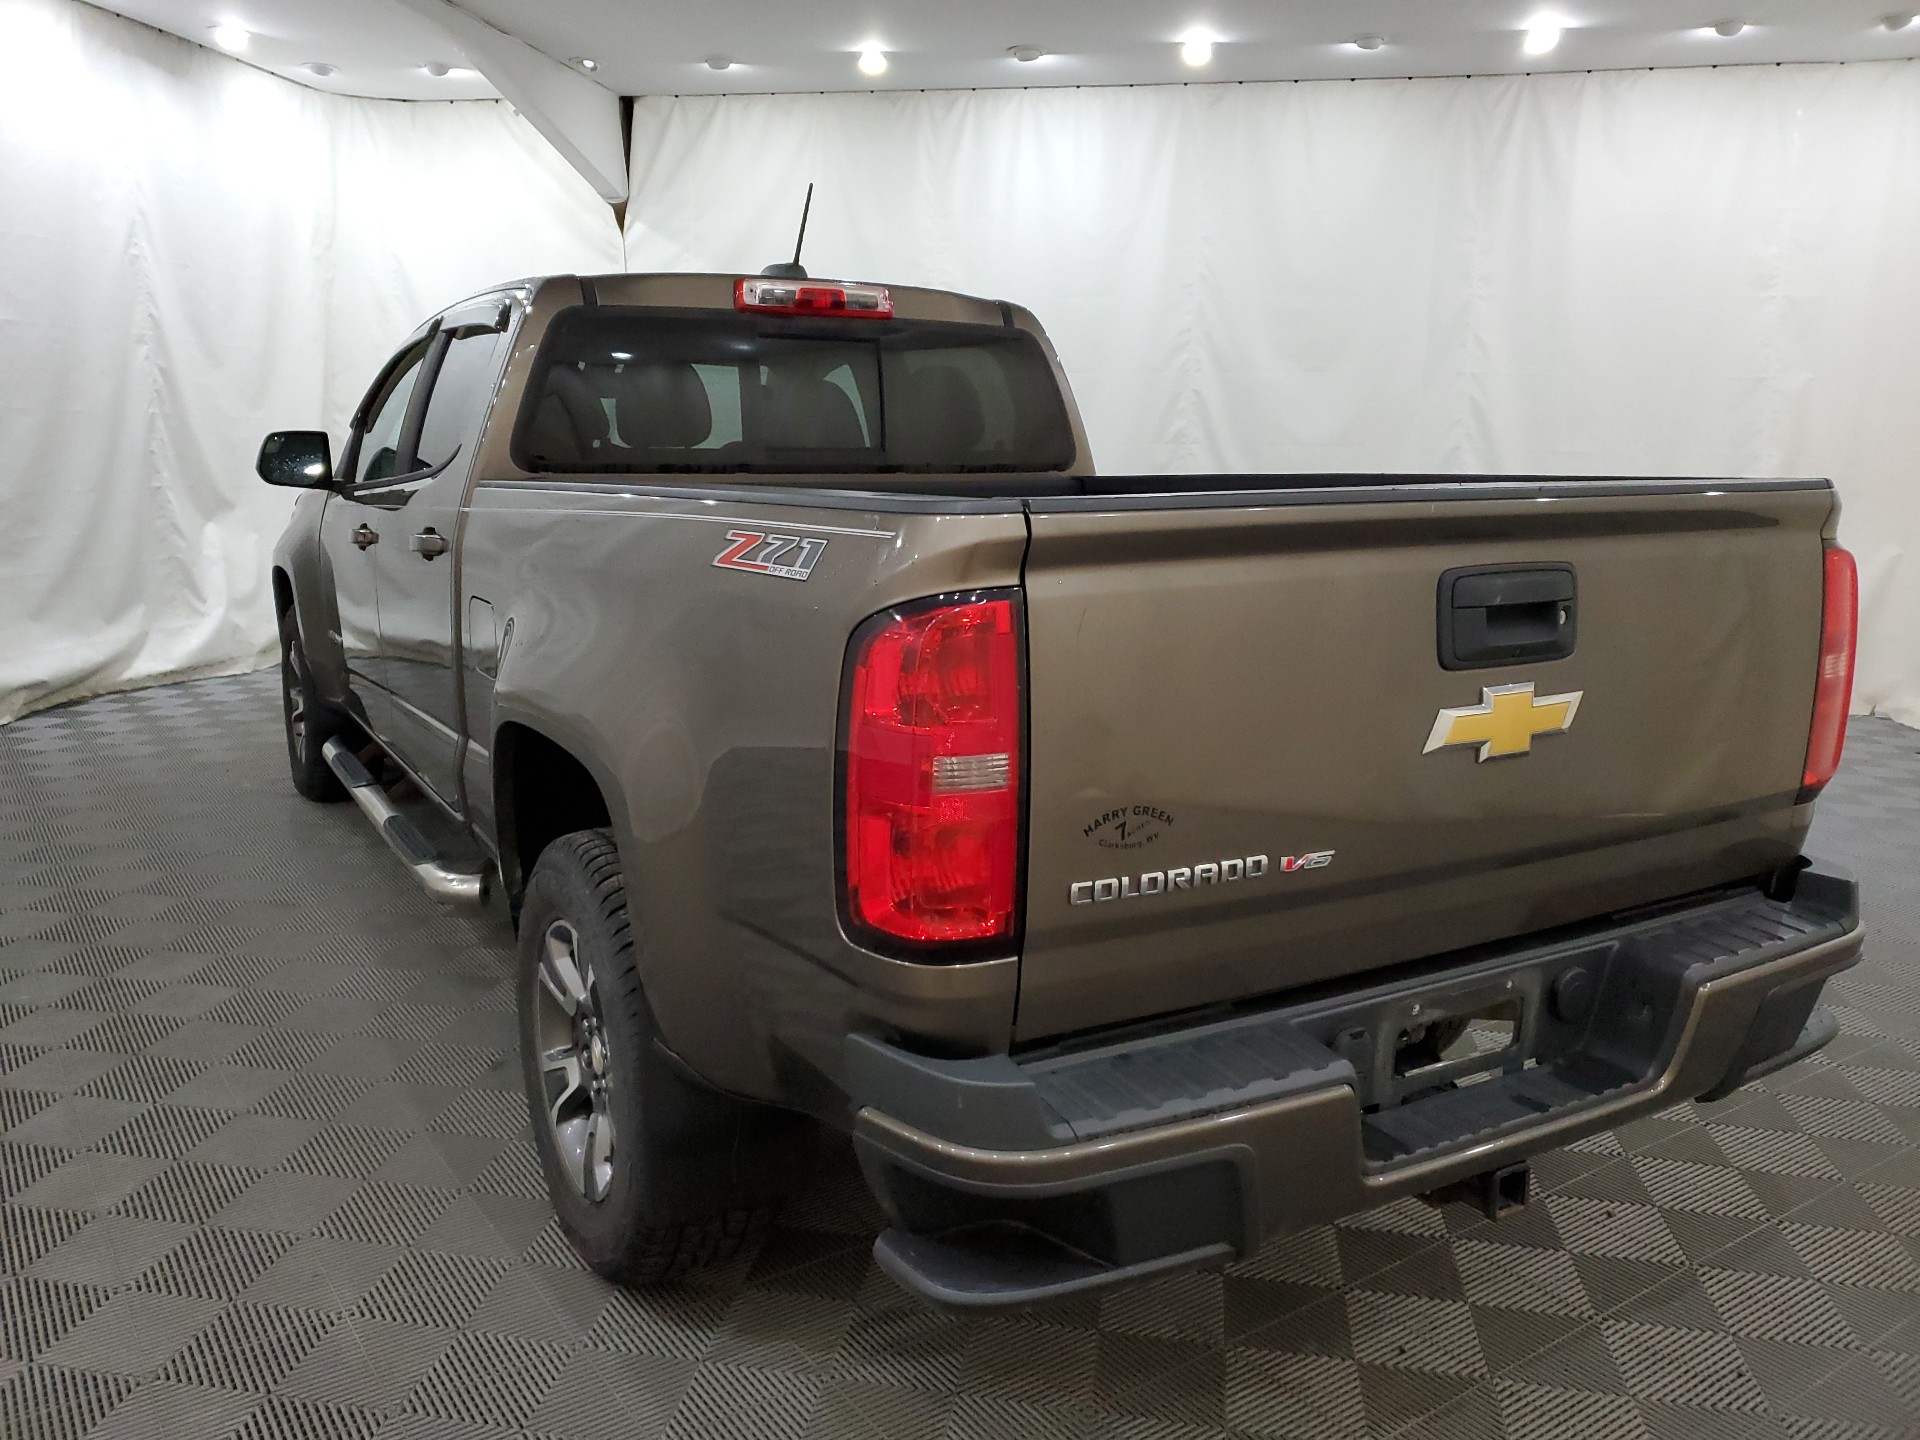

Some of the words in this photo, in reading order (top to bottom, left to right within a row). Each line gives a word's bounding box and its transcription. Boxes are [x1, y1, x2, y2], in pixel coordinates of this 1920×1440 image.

[711, 529, 828, 574] Z71
[768, 566, 785, 576] OFF
[785, 568, 809, 579] ROAD
[1083, 806, 1128, 837] HARRY
[1133, 805, 1174, 827] GREEN
[1114, 820, 1127, 841] 7
[1070, 854, 1269, 906] COLORADO
[1279, 849, 1336, 873] V6
